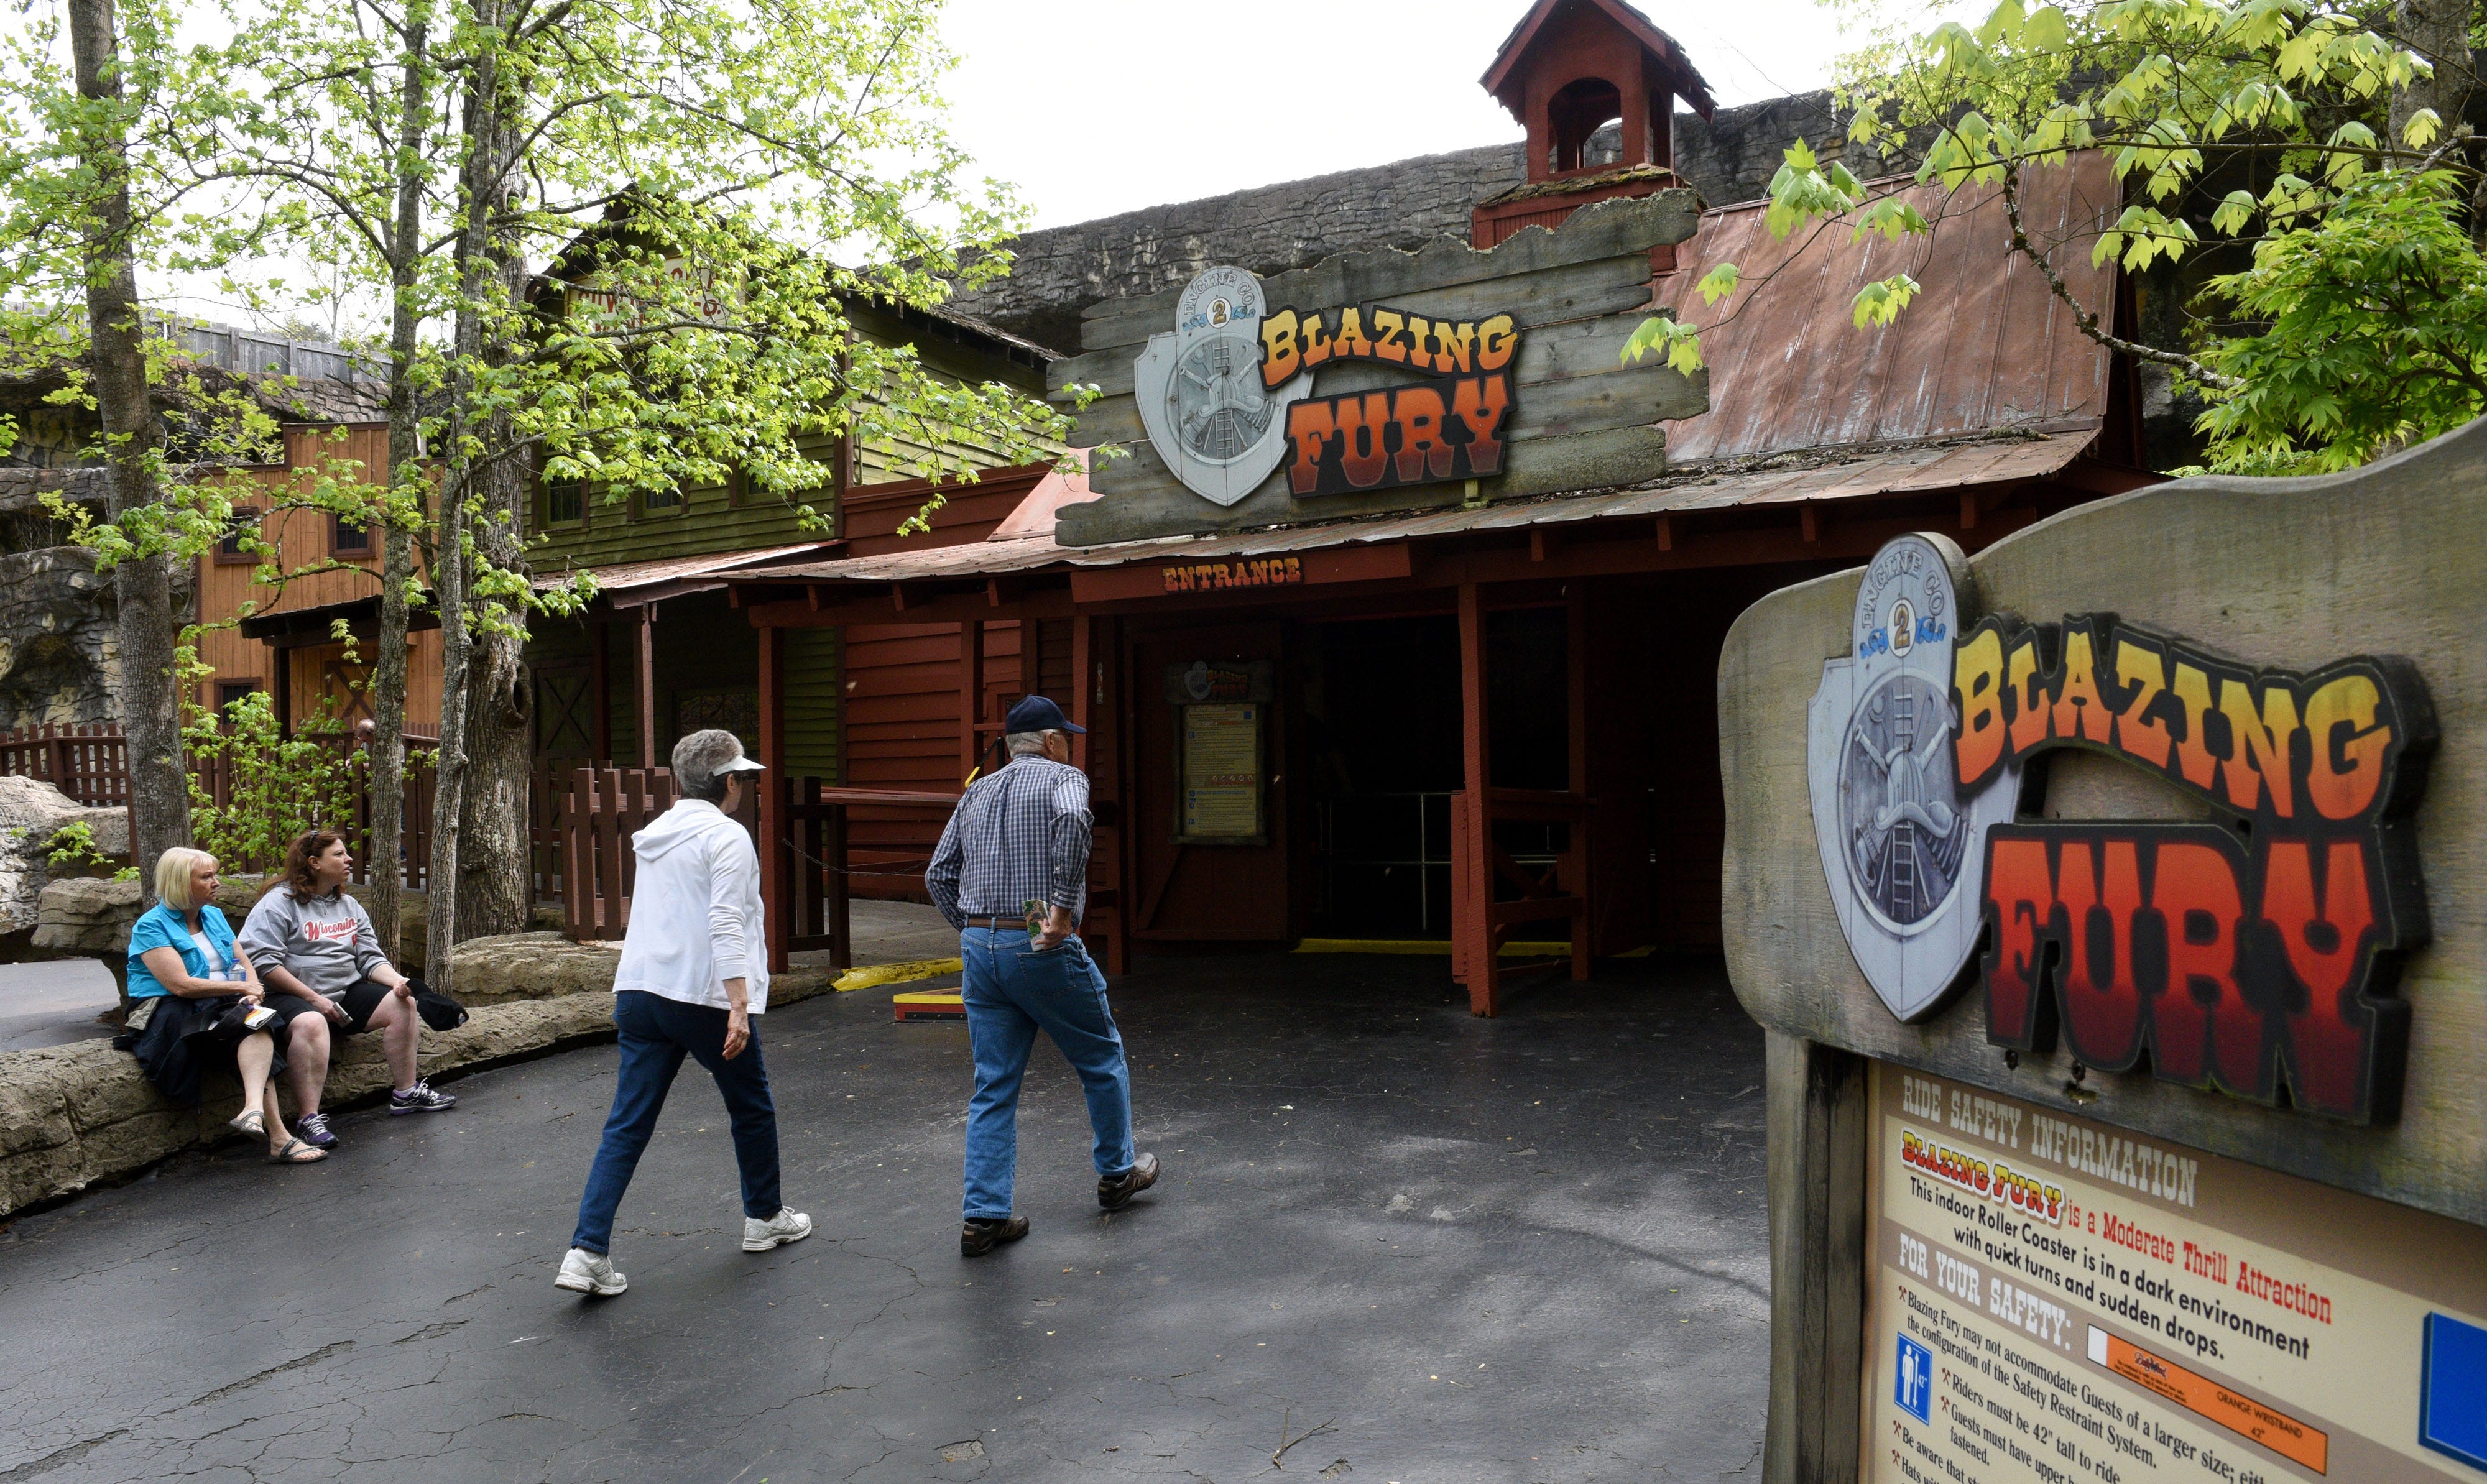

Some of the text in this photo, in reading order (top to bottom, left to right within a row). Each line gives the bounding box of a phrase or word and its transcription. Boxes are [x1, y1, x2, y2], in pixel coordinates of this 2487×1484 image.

[1184, 272, 1255, 315] ENGINE CO
[1212, 300, 1227, 325] 2
[1261, 307, 1519, 386] BLAZING
[1286, 376, 1508, 494] FURY
[1162, 558, 1301, 591] ENTRANCE
[1862, 550, 1944, 628] ENGINE CO
[1894, 604, 1910, 650] 2
[1954, 629, 2390, 819] BLAZING
[304, 917, 357, 942] Wisconsin
[1990, 840, 2373, 1117] FURY
[1903, 1075, 2197, 1207] RIDE SAFETY INFORMATION
[1902, 1130, 2332, 1325] BLAZING FURY is a Moderate Thrill Attraction
[1910, 1176, 2309, 1360] This indoor Roller Coaster is in a dark environment
[1899, 1233, 2071, 1351] FOR YOUR SAFETY:
[1954, 1227, 2224, 1360] with quick turns and sudden drops.
[1908, 1291, 1938, 1326] Blazing
[1940, 1309, 1960, 1334] Fury
[1963, 1326, 1983, 1350] may
[1985, 1337, 2001, 1357] not
[2005, 1348, 2077, 1397] accommodate
[2081, 1384, 2123, 1422] Guests
[2126, 1411, 2139, 1431] of
[2143, 1421, 2150, 1437] a
[2155, 1422, 2197, 1459] larger
[2201, 1449, 2234, 1484] size;
[1908, 1314, 2157, 1468] the configuration of the Safety Restraint System.
[2217, 1391, 2302, 1439] ORANGE WRISTBAND
[1903, 1426, 1965, 1484] Be aware that
[1950, 1426, 1990, 1466] fastened.
[1951, 1403, 2065, 1484] Guests must have upper
[1952, 1373, 2120, 1484] Riders must be 42" tall to ride
[1901, 1456, 1921, 1484] Hats
